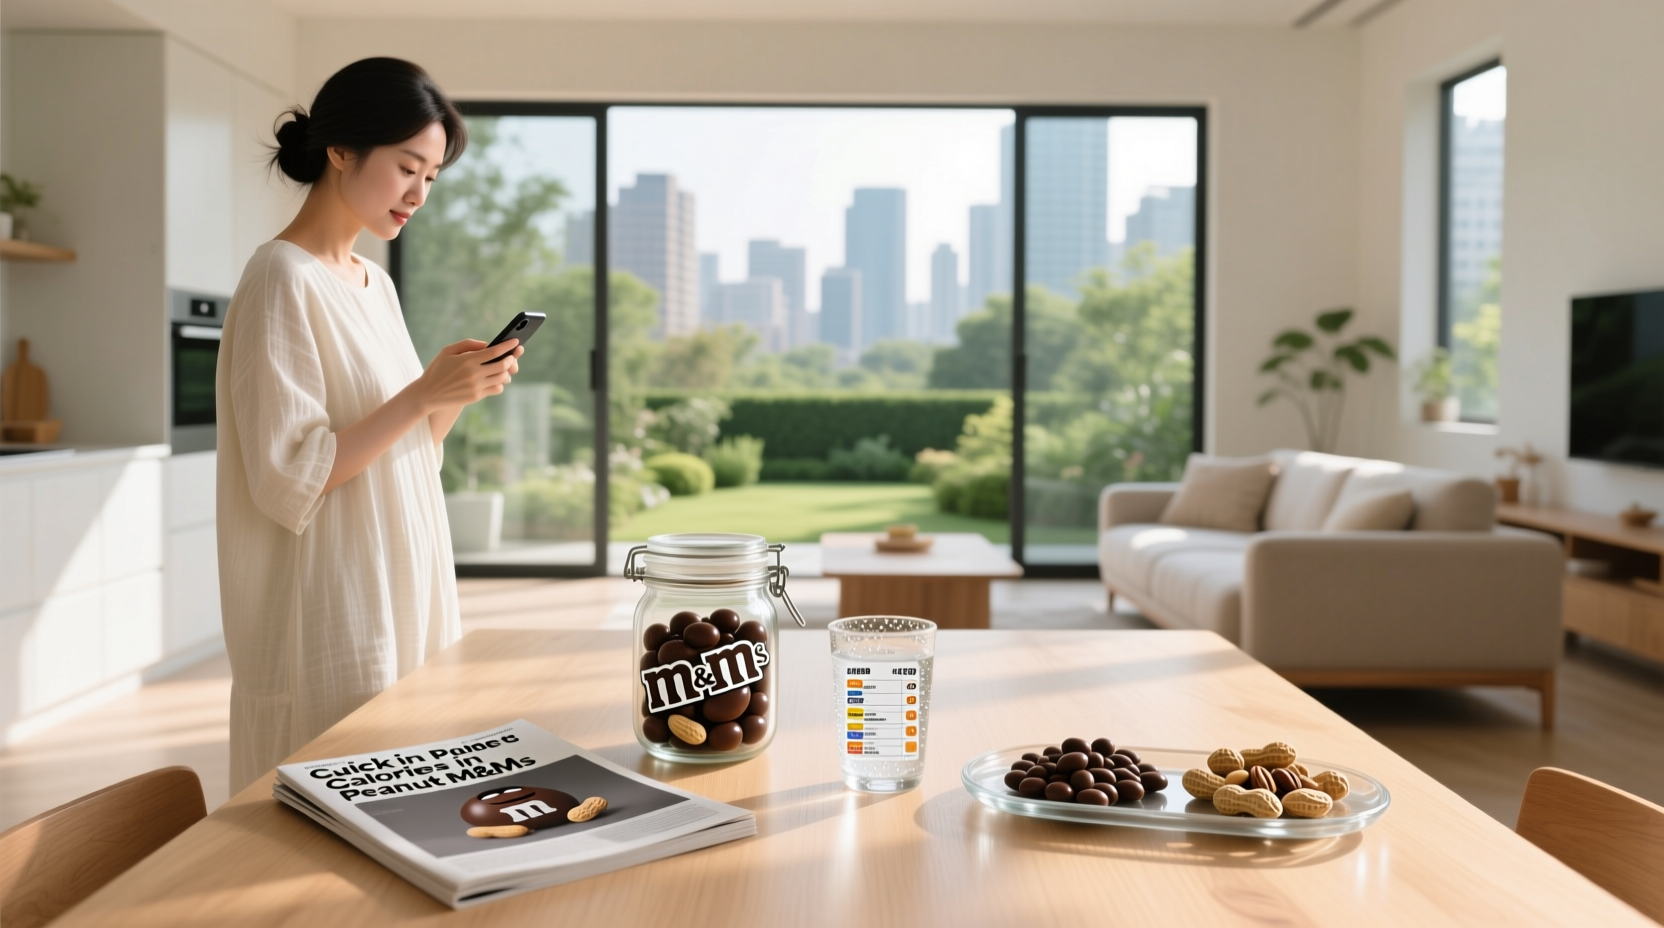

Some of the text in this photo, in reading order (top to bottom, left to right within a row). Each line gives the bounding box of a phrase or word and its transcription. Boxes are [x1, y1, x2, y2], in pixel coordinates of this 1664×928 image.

[326, 763, 450, 789] Calories
[453, 756, 483, 767] in
[394, 754, 426, 766] in
[339, 757, 536, 801] Peanut M&Ms
